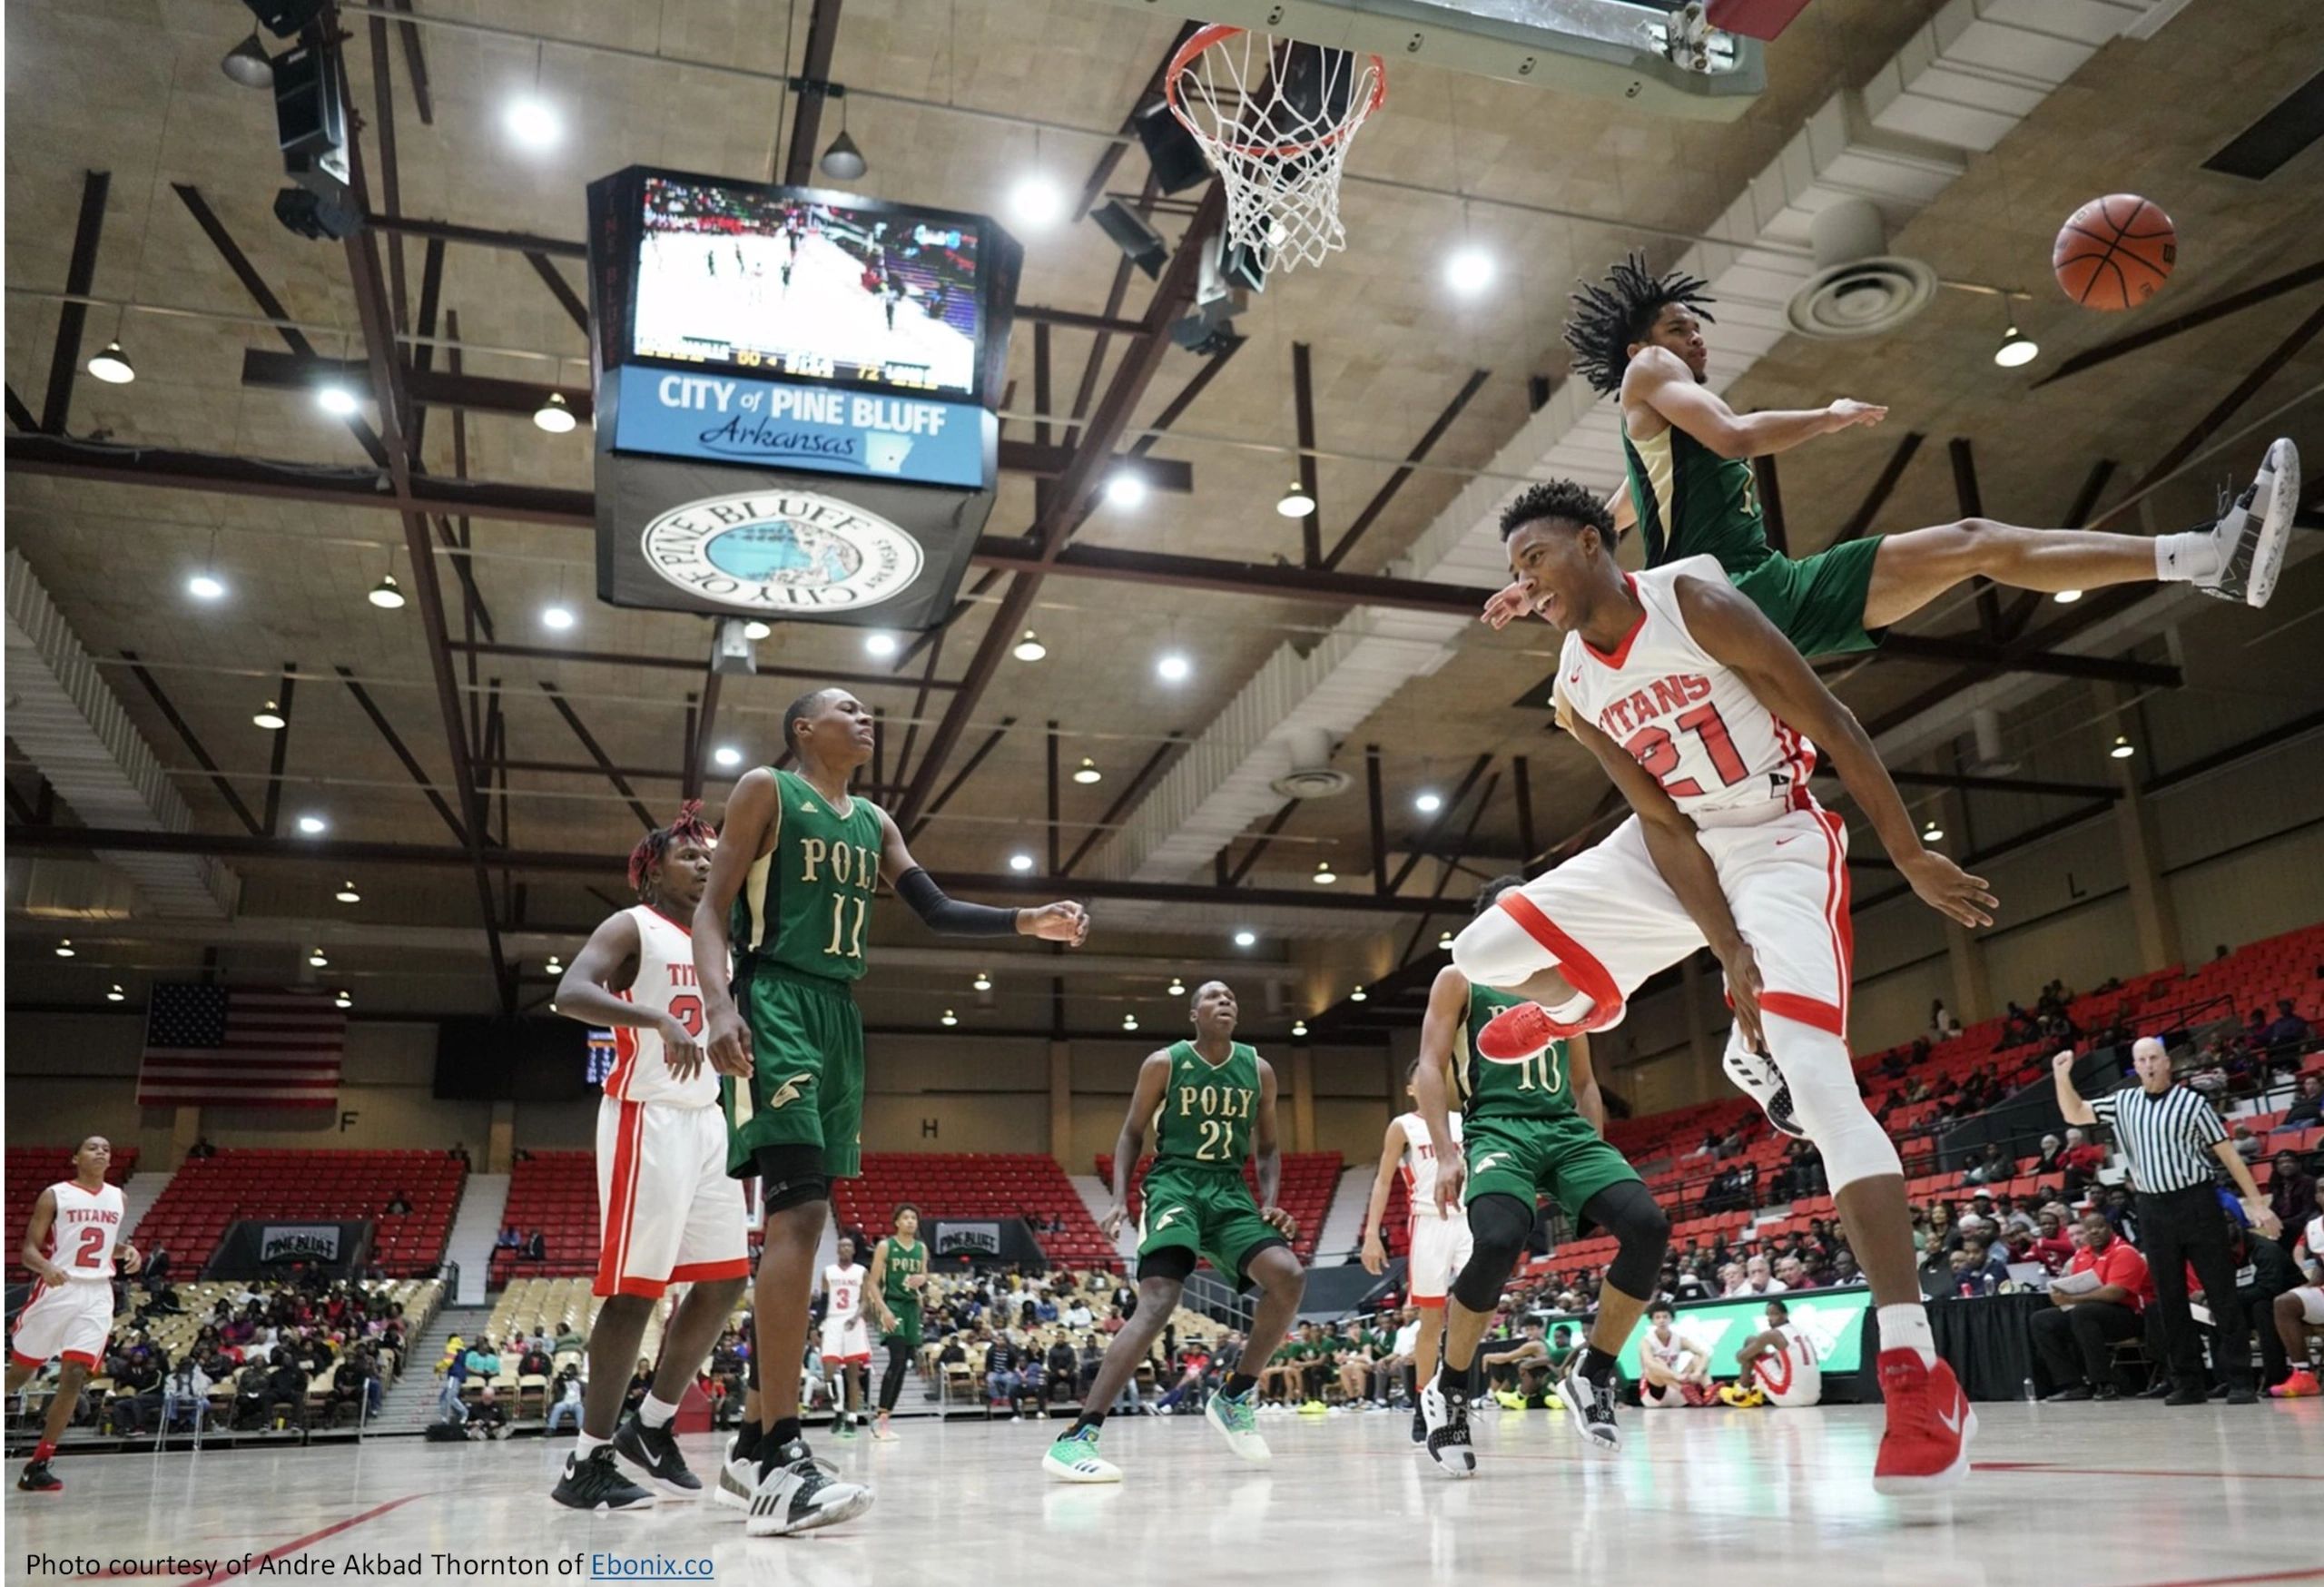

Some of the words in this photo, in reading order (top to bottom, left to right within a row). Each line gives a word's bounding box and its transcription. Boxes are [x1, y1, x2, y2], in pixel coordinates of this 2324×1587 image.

[658, 376, 736, 412] CITY
[740, 390, 765, 413] of
[772, 388, 845, 425] PINE
[852, 399, 948, 436] BLUFF
[699, 414, 858, 455] Arkansas
[708, 498, 872, 532] BLUFF
[655, 517, 713, 566] PINE
[677, 571, 739, 595] OF
[749, 586, 858, 605] CITY
[1599, 674, 1712, 737] ITANS
[1625, 701, 1750, 797] 21
[2066, 872, 2087, 899] L
[823, 892, 865, 959] 11
[1517, 1044, 1561, 1094] 10
[1179, 1085, 1254, 1118] POLY
[340, 1110, 359, 1132] F
[922, 1118, 938, 1138] H
[1196, 1119, 1234, 1160] 21
[66, 1208, 120, 1225] TITANS
[74, 1226, 105, 1268] 2
[836, 1287, 851, 1309] 3
